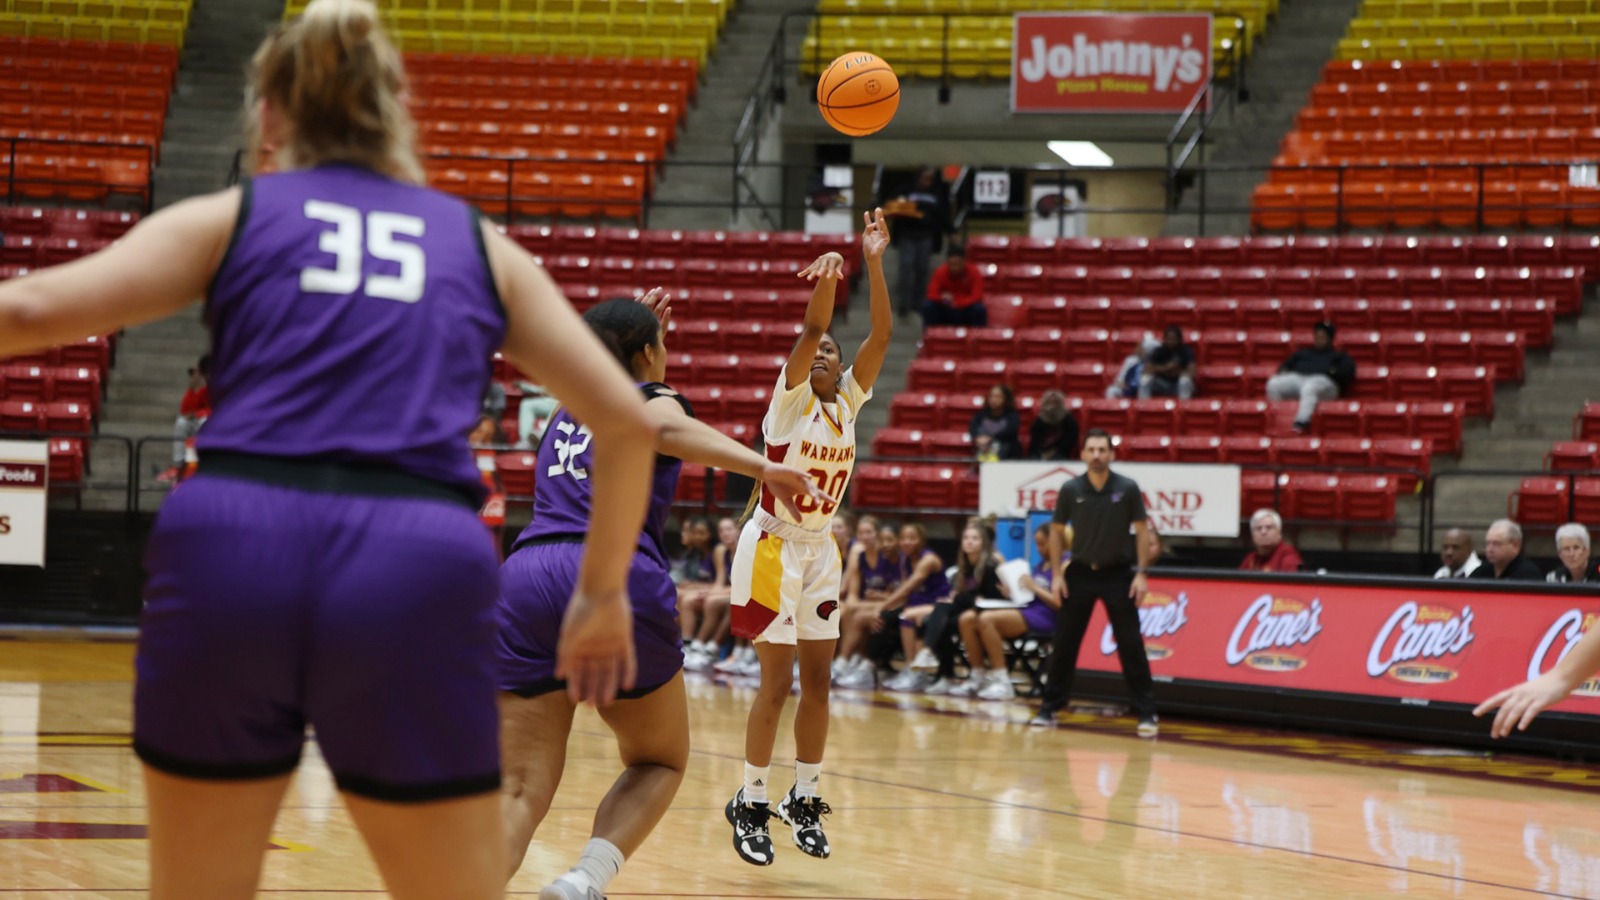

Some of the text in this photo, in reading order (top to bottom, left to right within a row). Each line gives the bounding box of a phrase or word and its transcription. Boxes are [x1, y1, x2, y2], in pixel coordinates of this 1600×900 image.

[1020, 33, 1204, 92] Johnny's
[979, 179, 1010, 197] 113
[300, 199, 426, 304] 35
[547, 421, 594, 480] 32
[1226, 594, 1323, 666] Cane's
[1367, 601, 1475, 678] Cane's
